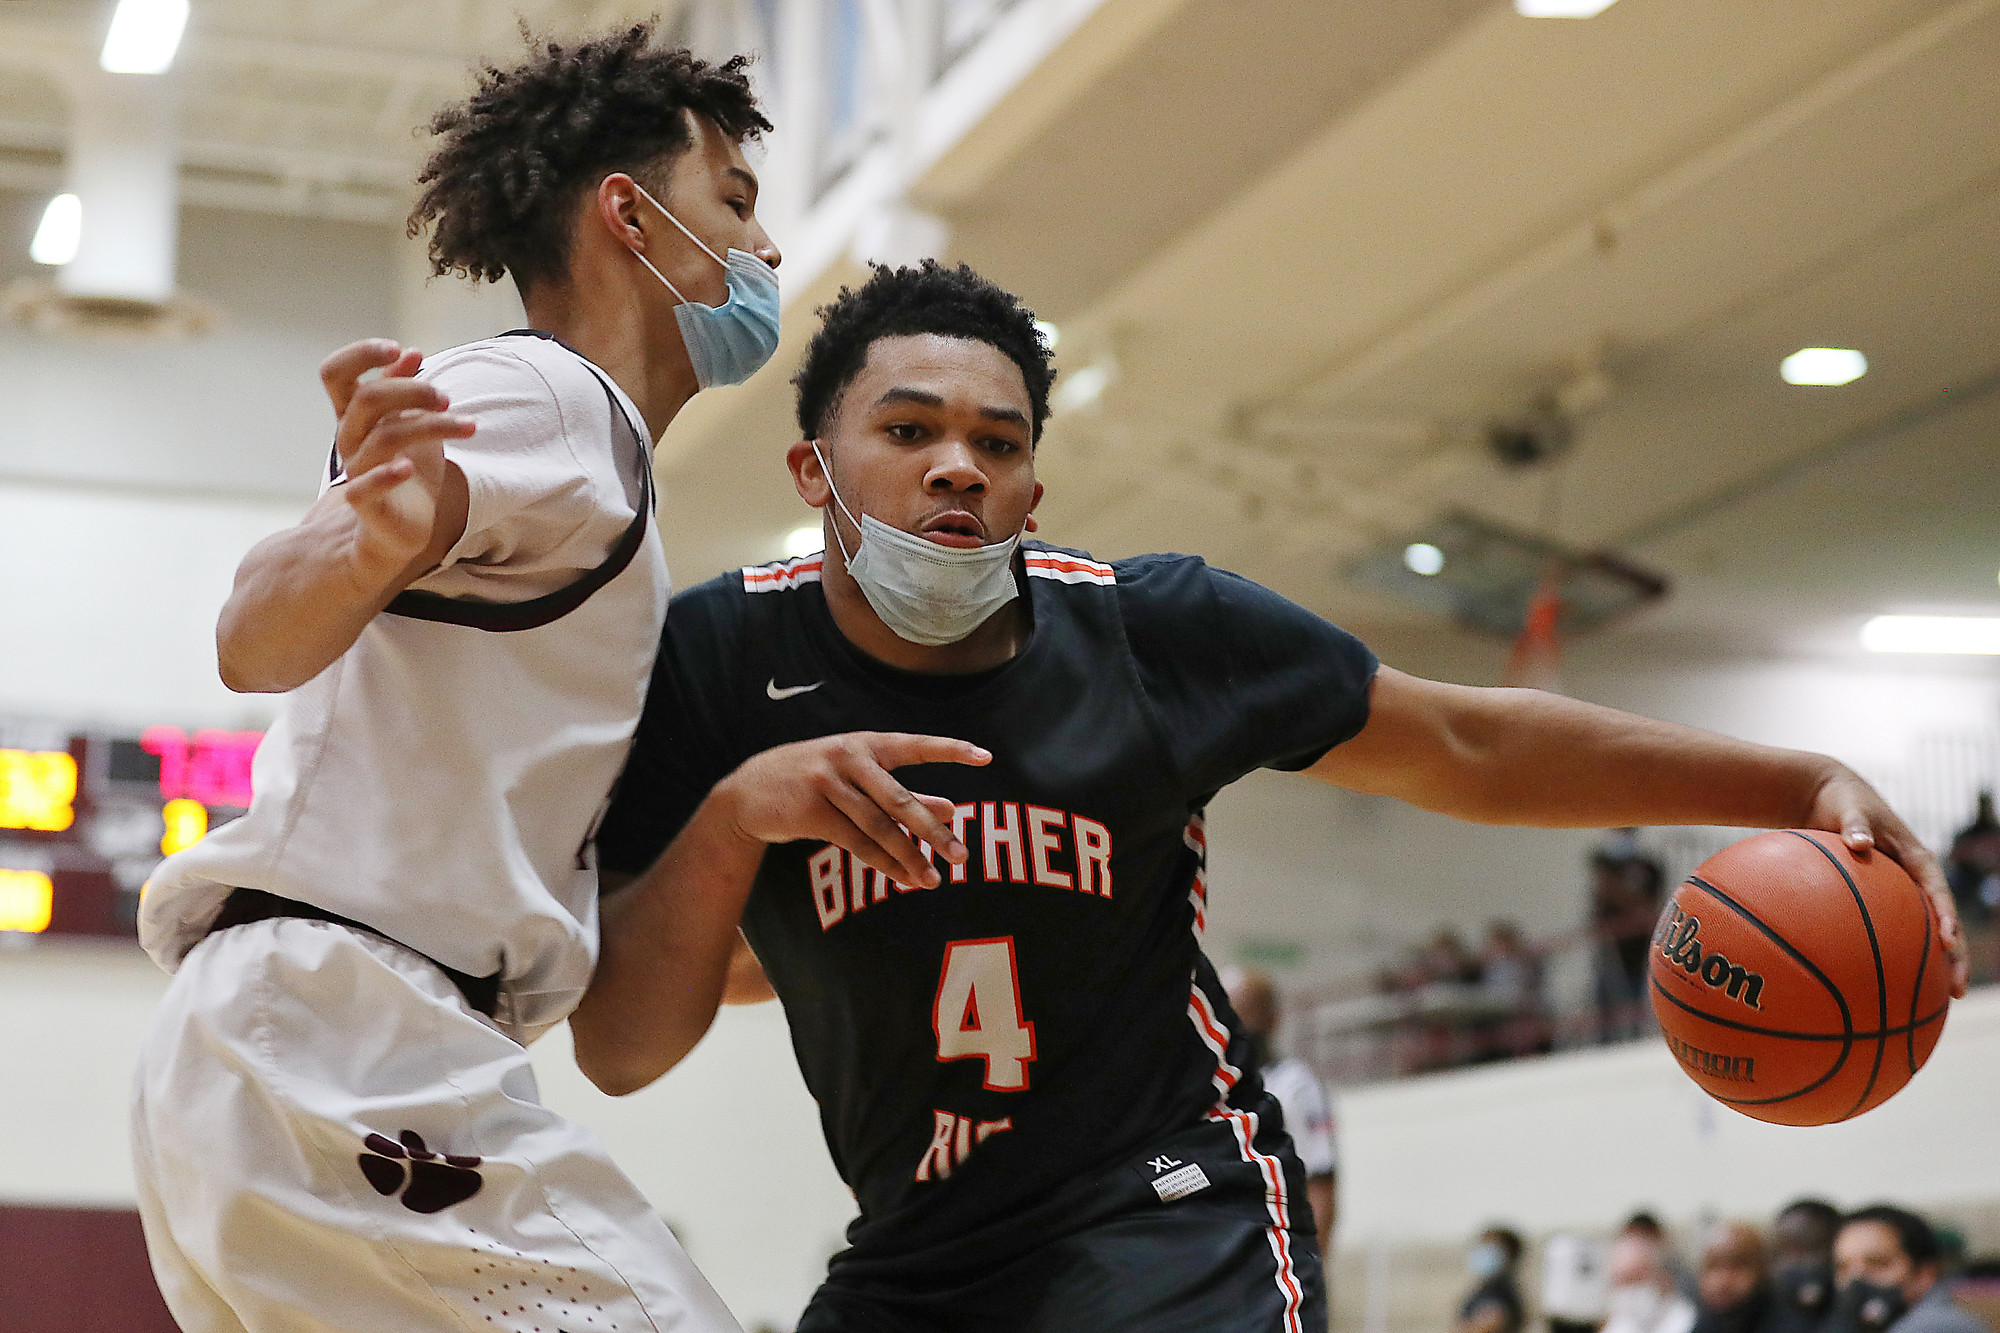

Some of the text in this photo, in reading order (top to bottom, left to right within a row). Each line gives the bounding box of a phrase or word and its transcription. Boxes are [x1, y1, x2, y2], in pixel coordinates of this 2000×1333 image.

[808, 801, 1113, 932] BTHER
[932, 935, 1038, 1092] 4
[1146, 1154, 1183, 1174] XL
